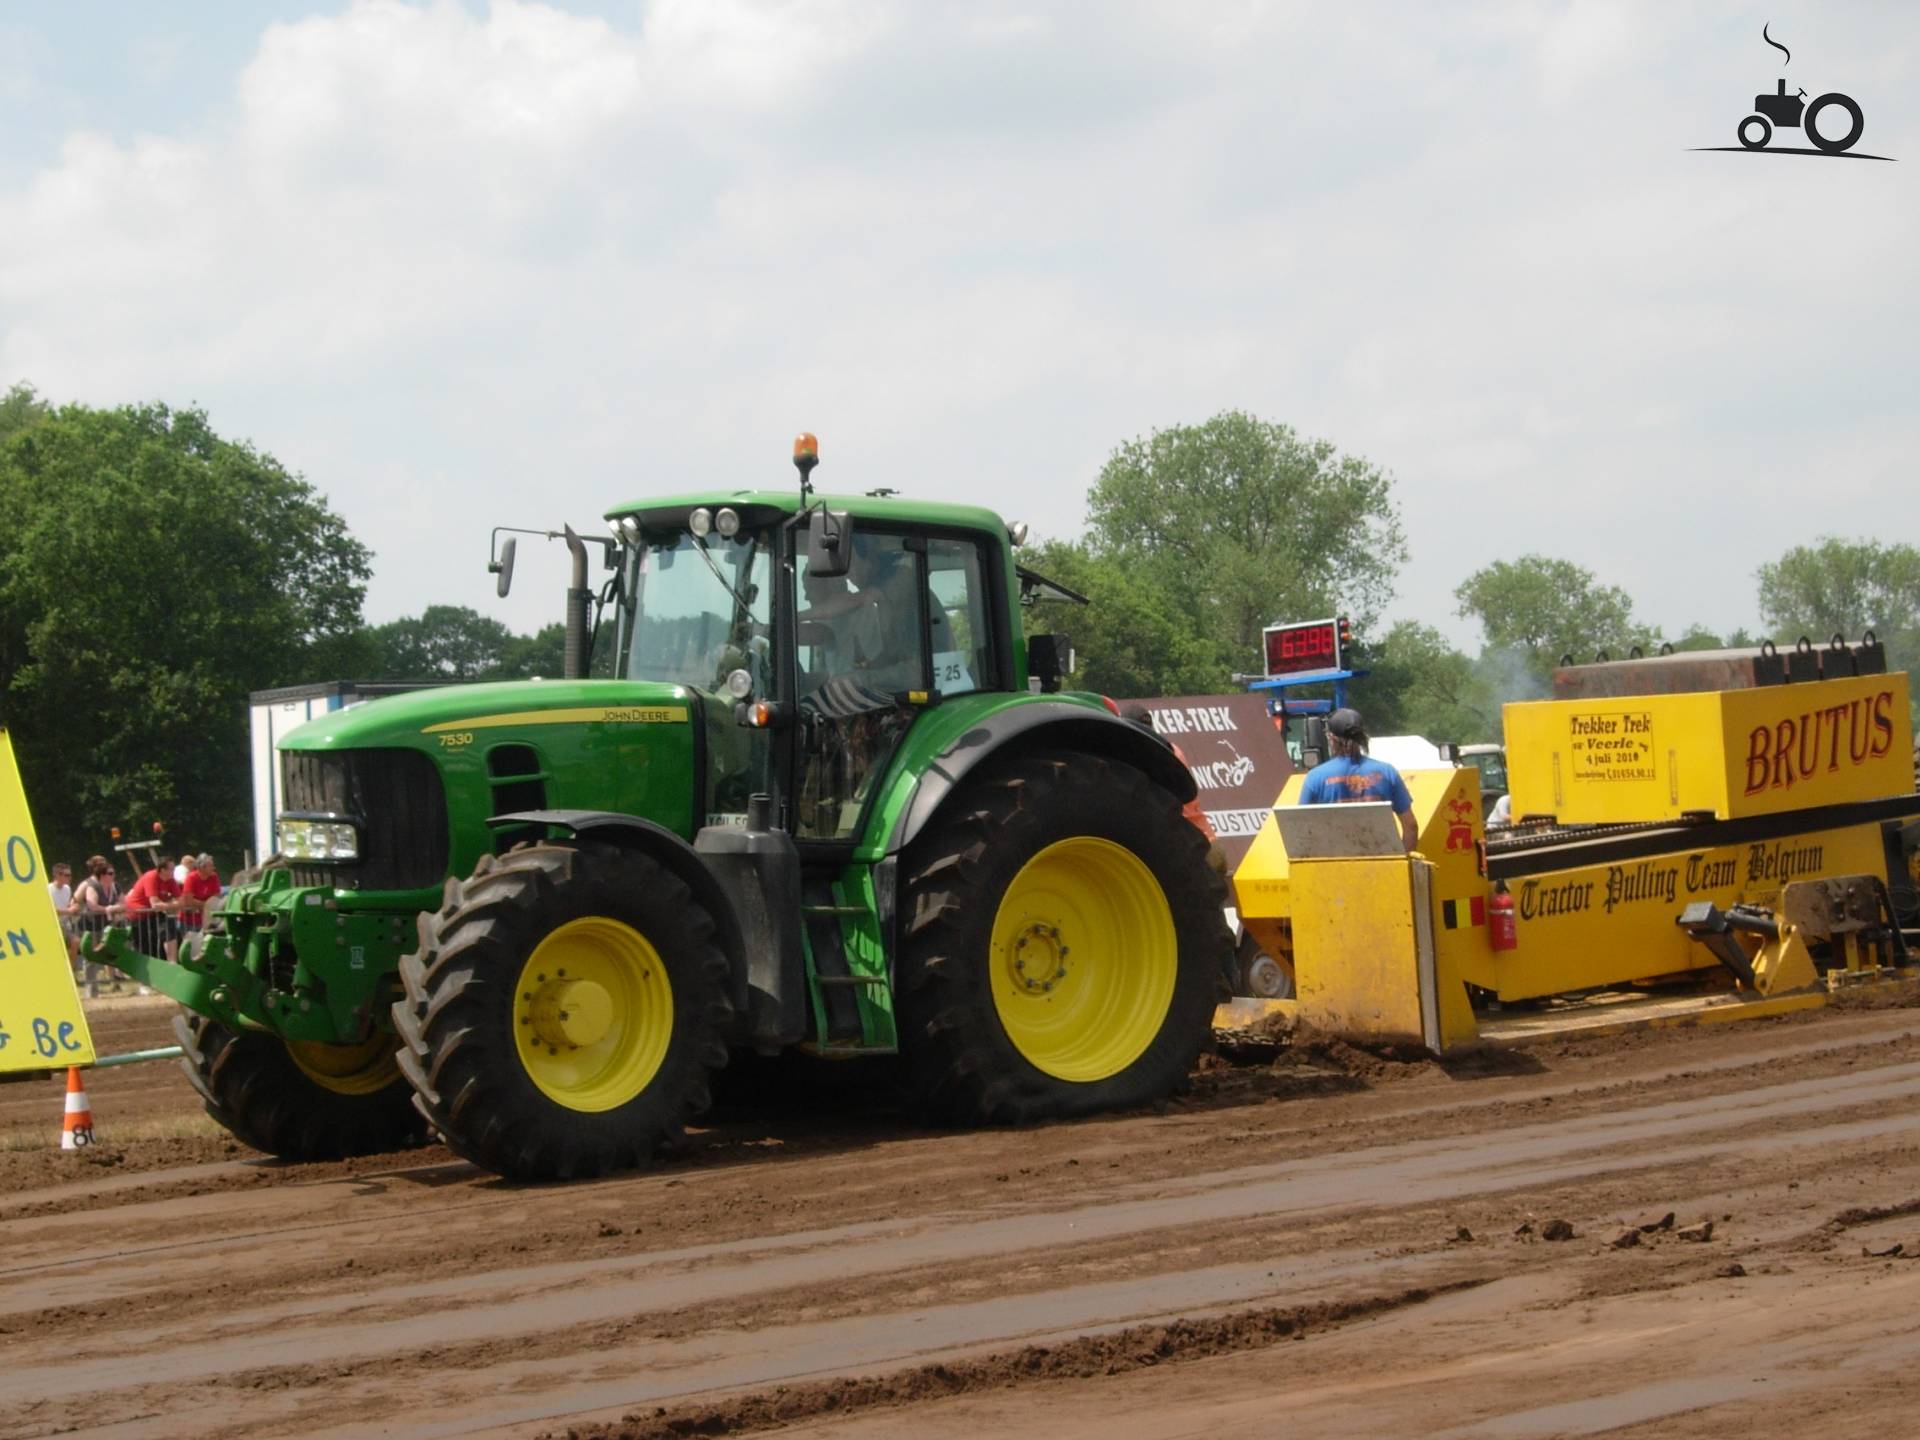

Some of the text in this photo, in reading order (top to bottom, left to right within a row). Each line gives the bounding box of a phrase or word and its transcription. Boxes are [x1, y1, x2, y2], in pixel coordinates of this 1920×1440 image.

[945, 663, 962, 681] 25
[601, 709, 670, 721] JOHN DEERE
[1571, 713, 1650, 735] Trekker Trek
[439, 732, 473, 747] 7530
[1744, 691, 1894, 797] BRUTUS
[1520, 840, 1824, 921] Tractor Pulling Team Belgium
